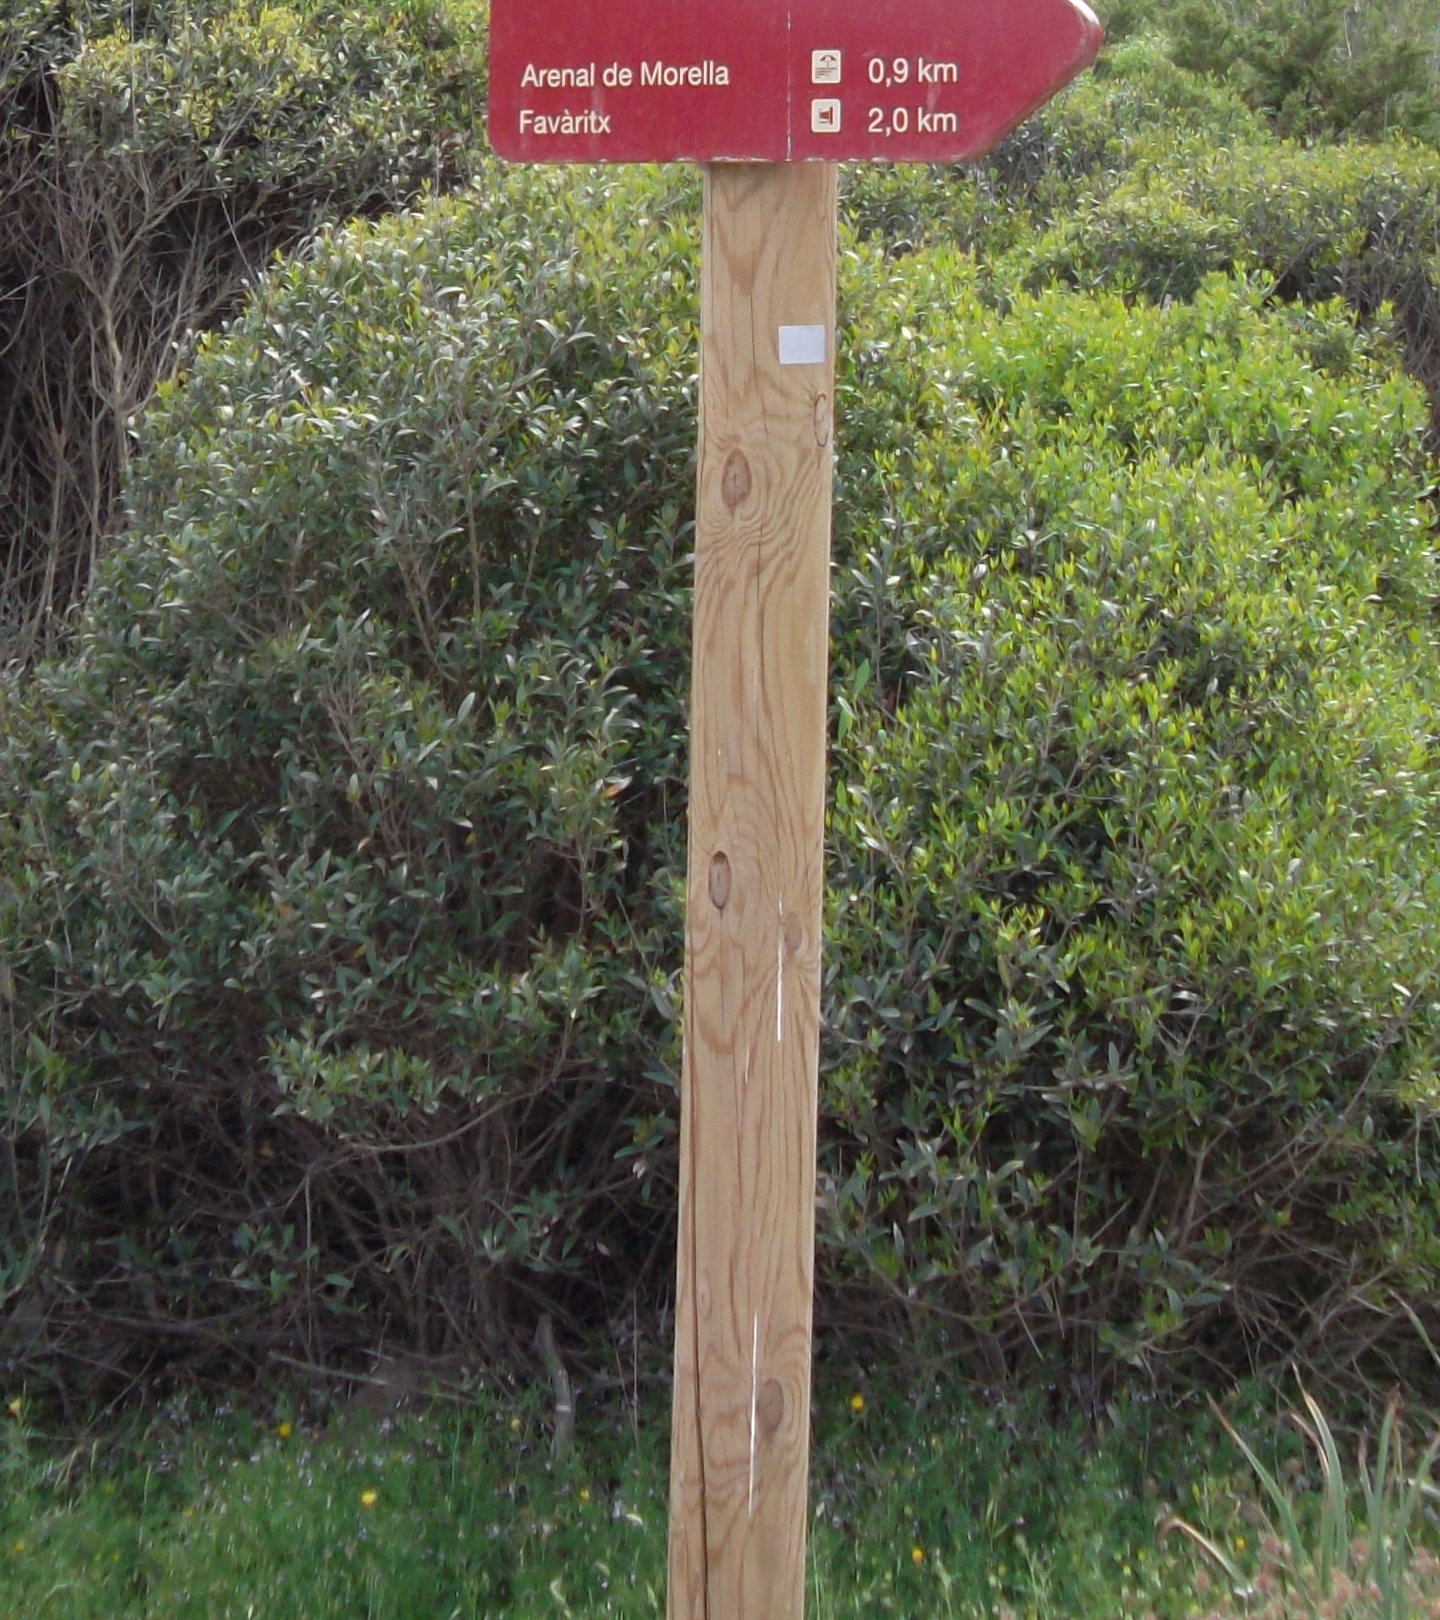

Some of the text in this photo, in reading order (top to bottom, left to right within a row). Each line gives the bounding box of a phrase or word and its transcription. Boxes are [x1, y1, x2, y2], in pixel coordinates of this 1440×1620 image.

[520, 60, 730, 88] Arenal de Morella
[868, 56, 958, 88] 0,9 km
[519, 108, 611, 134] Favàritx
[868, 106, 958, 137] 2,0 km
